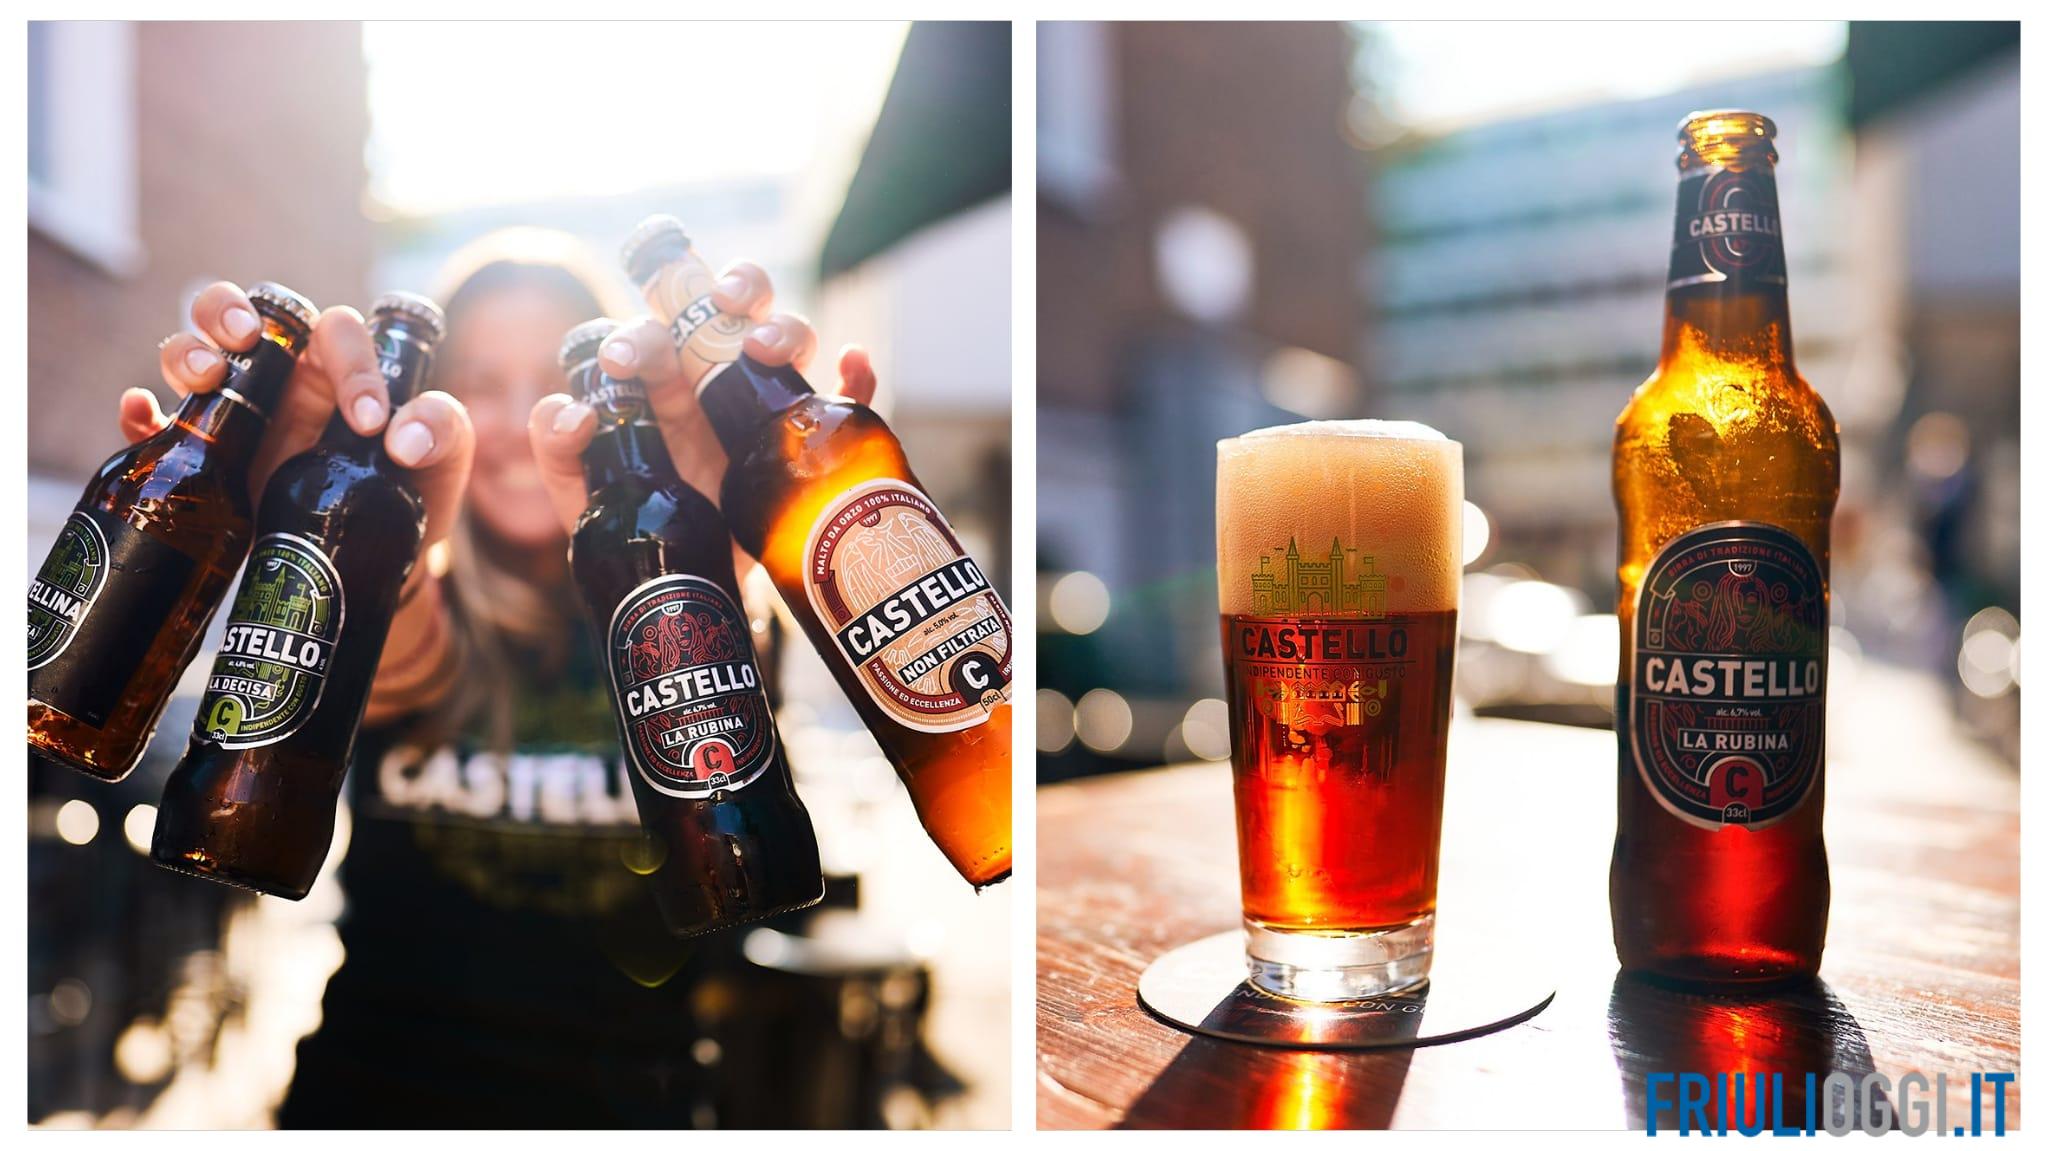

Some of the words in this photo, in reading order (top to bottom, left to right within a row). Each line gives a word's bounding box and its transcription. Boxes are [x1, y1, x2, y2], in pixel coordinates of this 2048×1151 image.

[671, 296, 719, 347] CAST
[863, 513, 878, 527] 1997
[817, 541, 831, 575] MALTO
[828, 525, 841, 540] DA
[839, 504, 863, 527] ORZO
[864, 494, 889, 510] 100%
[892, 493, 932, 515] ITALIANO
[1711, 544, 1771, 558] TRADIZIONE
[297, 557, 328, 592] ITALIANO
[1733, 563, 1753, 573] 1997
[28, 581, 82, 622] ELLINA
[648, 591, 692, 608] TRADIZIONE
[848, 561, 986, 657] CASTELLO
[221, 626, 321, 669] STELLO
[902, 653, 938, 682] NON
[939, 618, 1001, 660] FILTRATA
[1241, 628, 1409, 662] CASTELLO
[872, 661, 899, 694] PASSIONE
[898, 690, 910, 703] ED
[909, 696, 962, 711] ECCELLENZA
[961, 660, 990, 691] C
[1247, 666, 1329, 681] NDIPENDENTE
[1333, 667, 1361, 681] CON
[1645, 656, 1820, 698] CASTELLO
[209, 678, 220, 689] LA
[221, 678, 272, 699] DECISA
[626, 663, 756, 718] CASTELLO
[982, 691, 1002, 707] 50cl
[216, 701, 235, 726] C
[240, 710, 290, 732] INDIPENDENTE
[1716, 708, 1730, 717] alc.
[1730, 708, 1749, 718] 6,7%
[664, 729, 684, 746] LA
[688, 716, 744, 740] RUBINA
[1683, 731, 1708, 749] LA
[1714, 731, 1790, 751] RUBINA
[656, 761, 695, 778] ECCELLENZA
[703, 744, 723, 770] C
[710, 776, 727, 786] 33cl
[1725, 766, 1748, 799] C
[1726, 807, 1748, 819] 33cl
